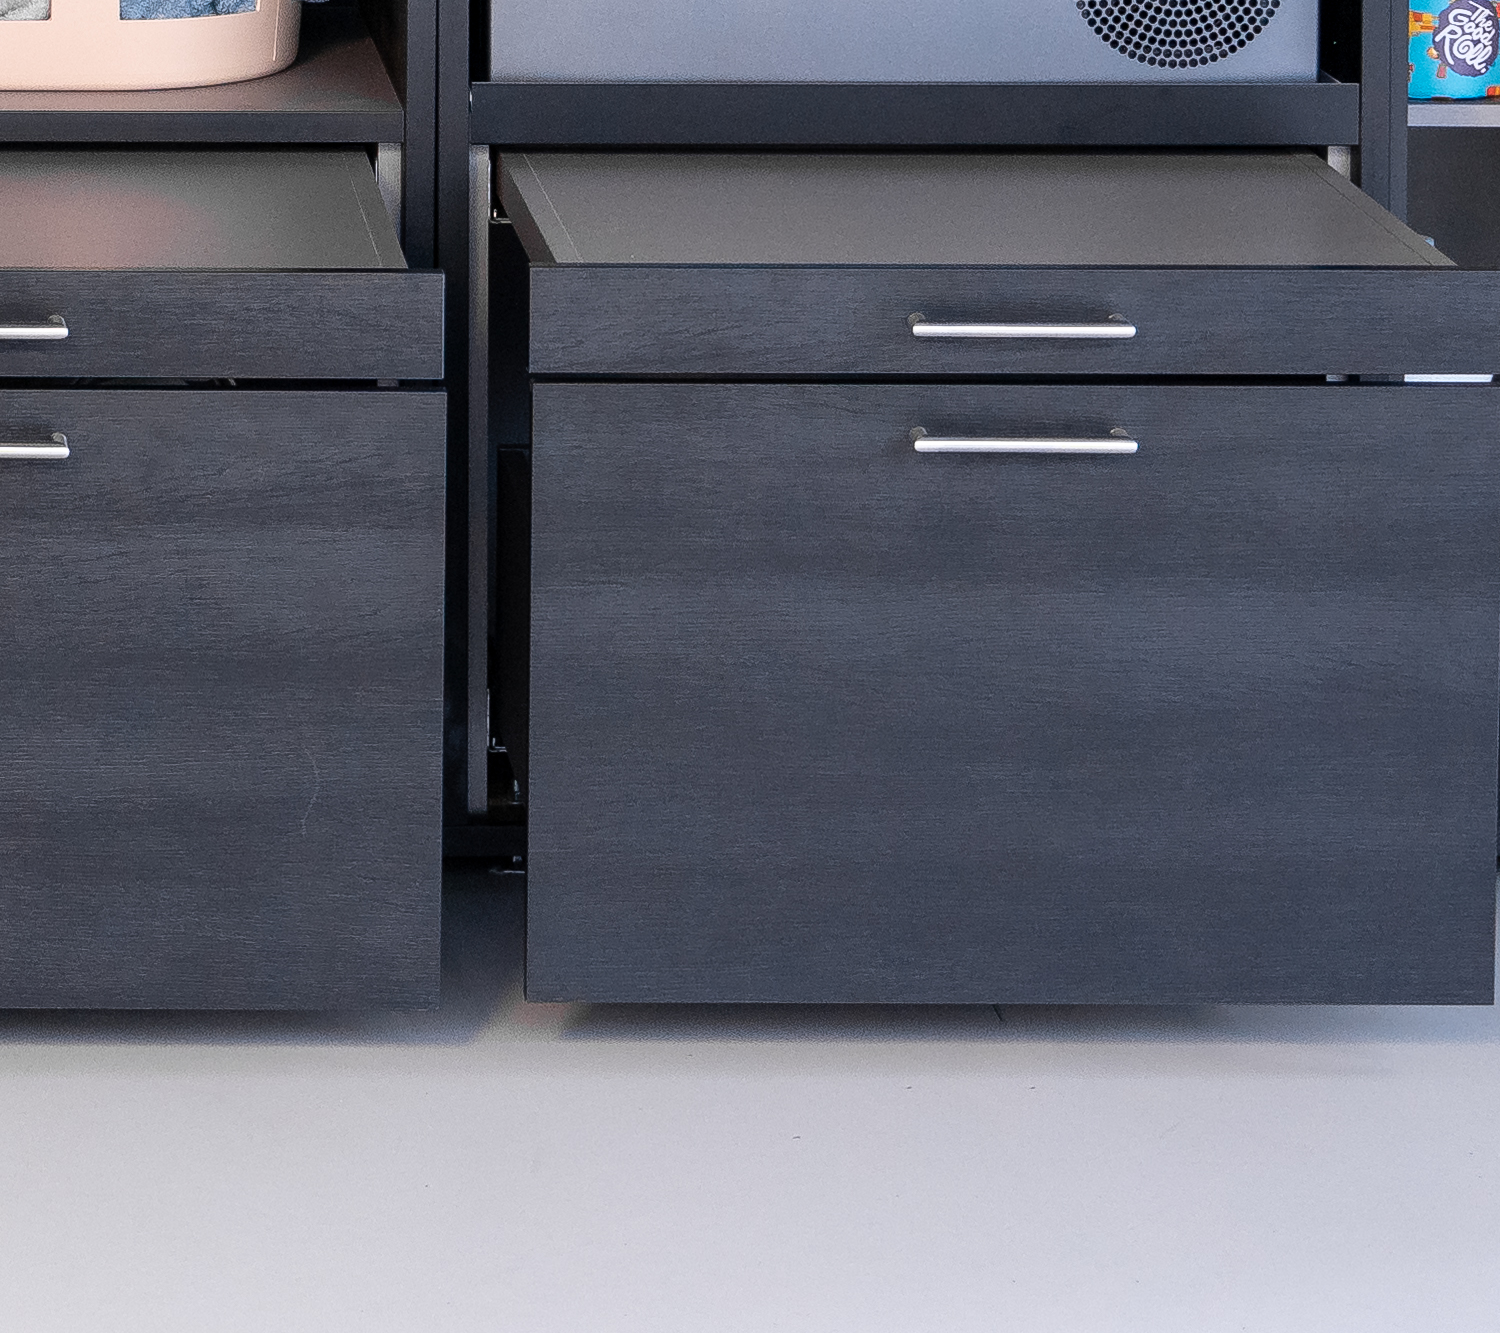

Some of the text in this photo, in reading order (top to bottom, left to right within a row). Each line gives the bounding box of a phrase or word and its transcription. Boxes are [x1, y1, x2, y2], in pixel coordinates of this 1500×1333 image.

[1447, 8, 1494, 47] Good
[1467, 0, 1496, 29] The
[1434, 27, 1493, 75] Roll.
